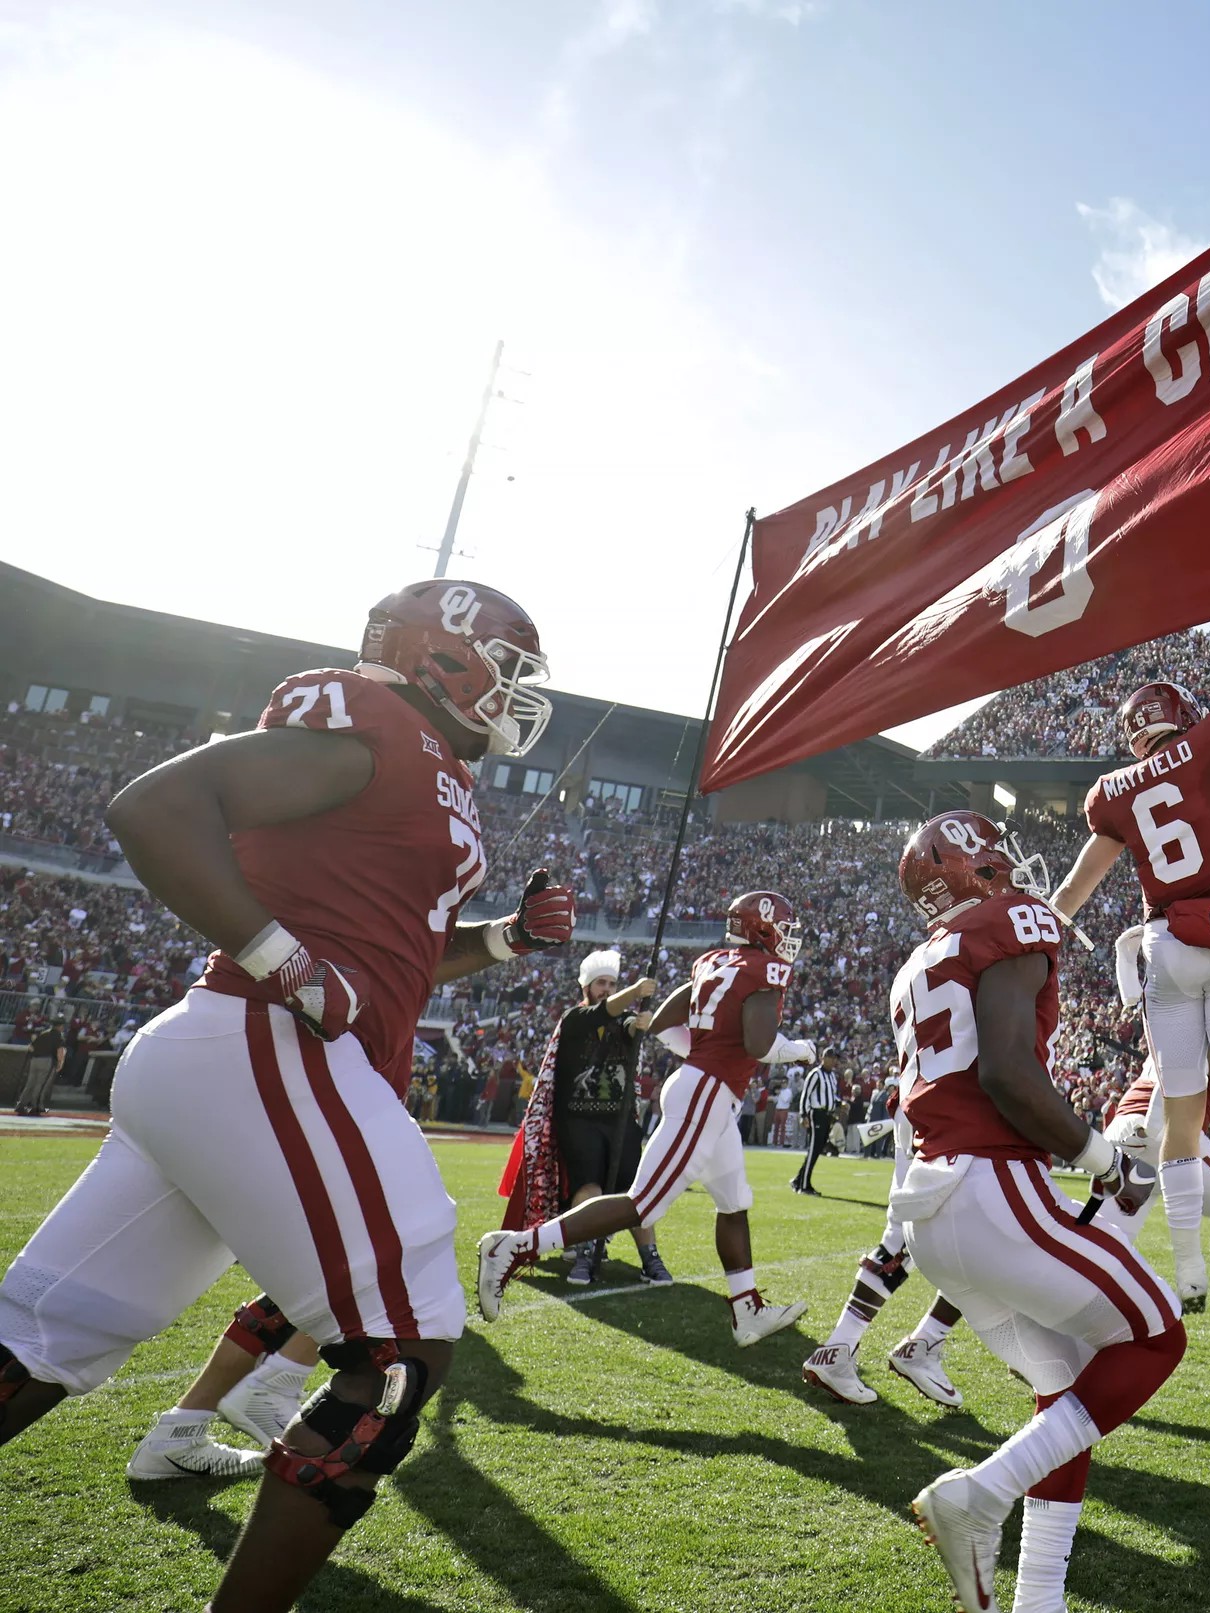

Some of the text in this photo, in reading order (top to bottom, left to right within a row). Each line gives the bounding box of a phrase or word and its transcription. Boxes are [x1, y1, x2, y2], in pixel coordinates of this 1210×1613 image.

[910, 387, 1047, 523] LIKE
[1055, 353, 1107, 457] A
[438, 586, 483, 636] OU
[282, 681, 353, 729] 71
[1135, 711, 1147, 728] 6
[1103, 741, 1193, 801] MAYFIELD
[940, 819, 986, 855] OU
[1131, 782, 1204, 884] 6
[759, 897, 775, 922] OU
[1007, 904, 1061, 945] 85
[766, 962, 791, 987] 87
[809, 1348, 839, 1365] NIKE
[170, 1424, 197, 1438] NIKE
